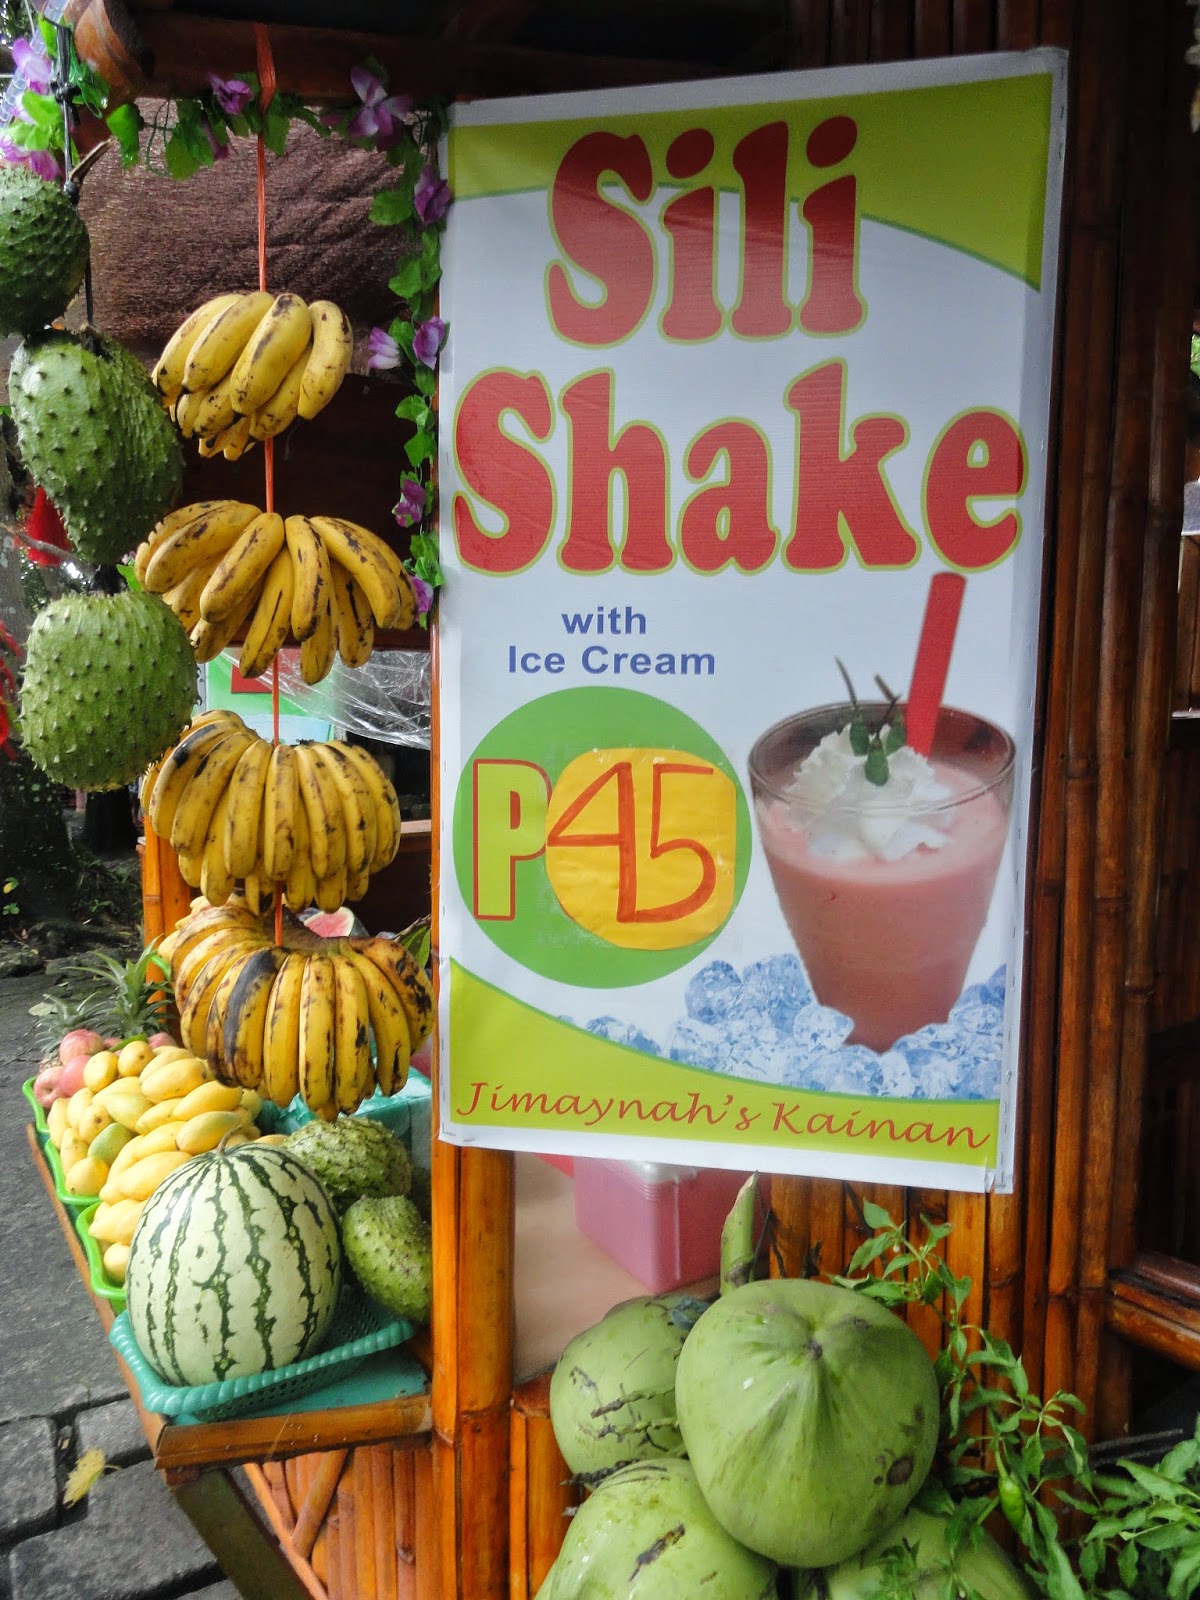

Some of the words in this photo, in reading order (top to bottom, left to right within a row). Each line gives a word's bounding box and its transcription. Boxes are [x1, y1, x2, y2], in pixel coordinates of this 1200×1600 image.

[547, 114, 866, 346] Sili
[453, 358, 1028, 576] Shake
[561, 606, 648, 635] with
[508, 646, 566, 675] Ice
[580, 646, 717, 676] Cream
[457, 1082, 762, 1132] Jimaynah's
[771, 1101, 991, 1150] Kainan
